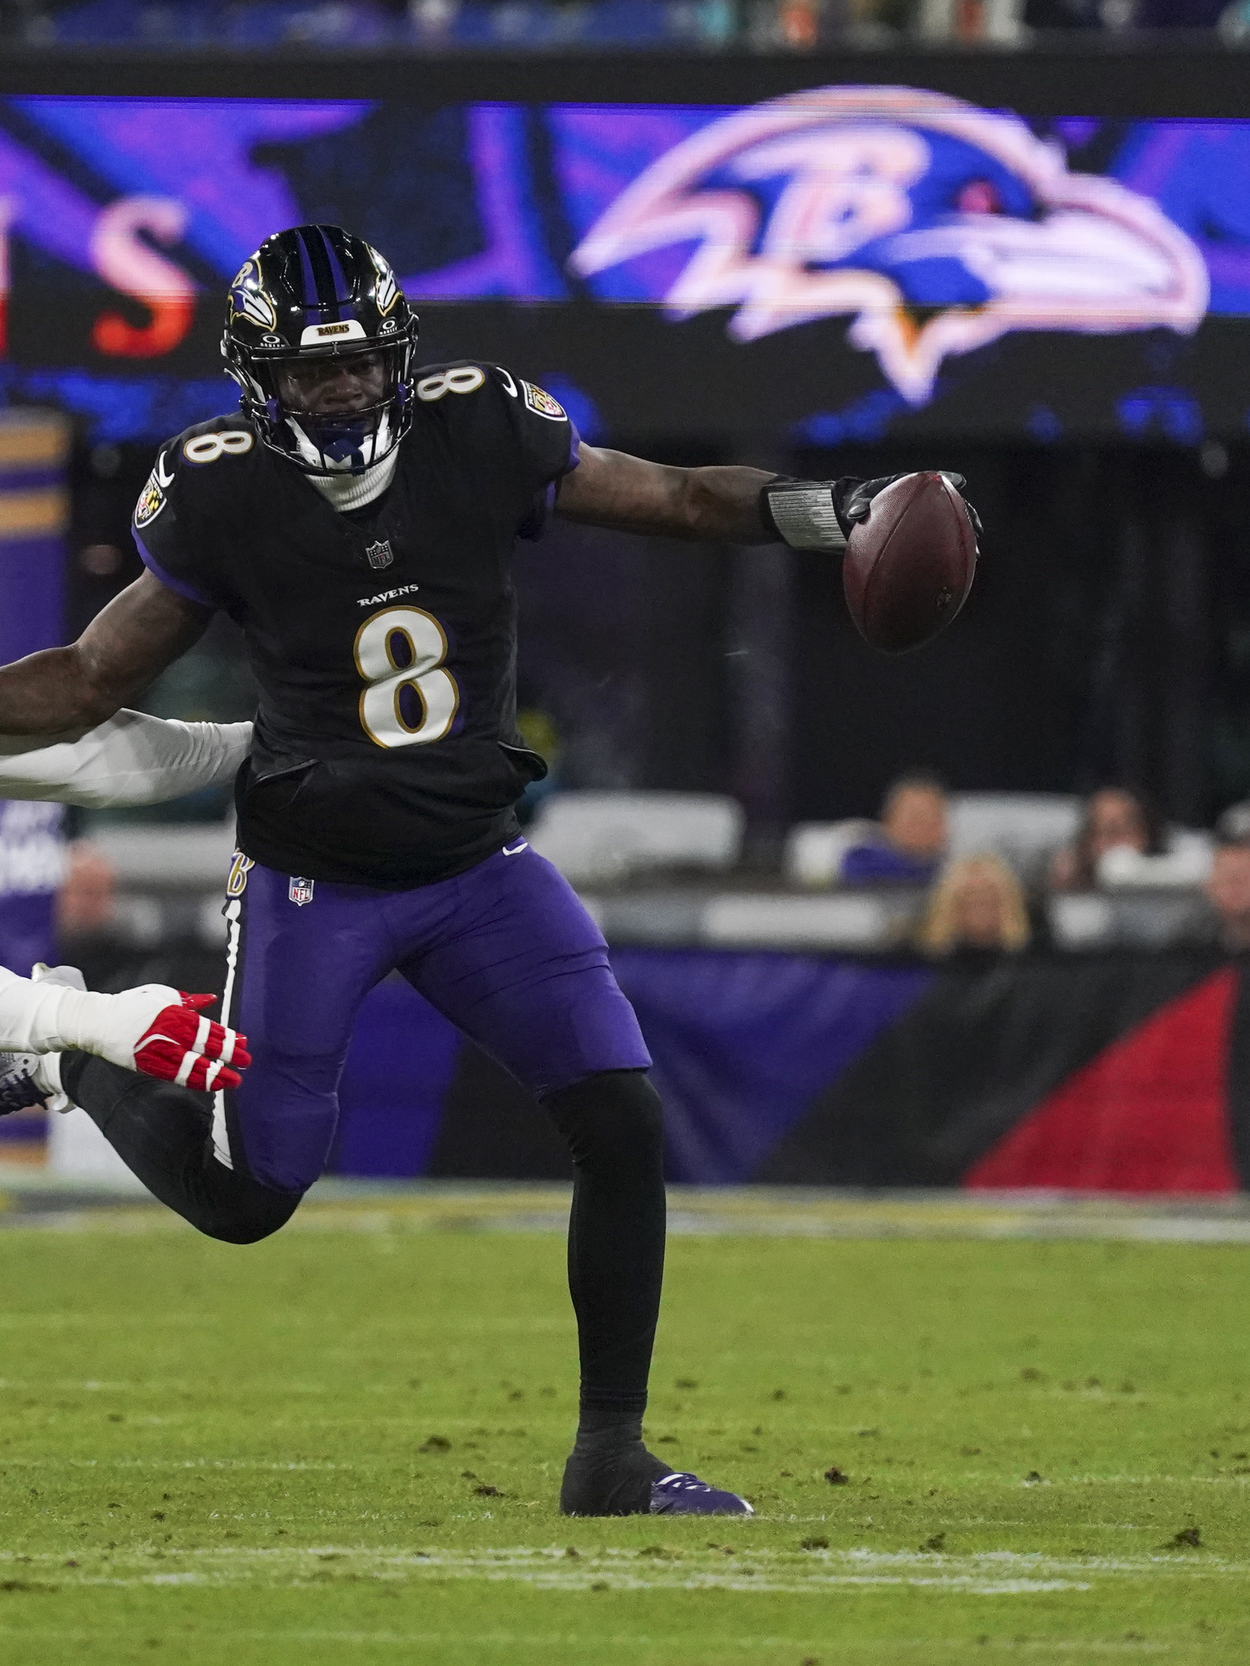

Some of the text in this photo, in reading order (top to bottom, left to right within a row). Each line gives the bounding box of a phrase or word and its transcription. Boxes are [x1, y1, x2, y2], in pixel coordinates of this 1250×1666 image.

[316, 324, 350, 337] RAVENS
[416, 366, 486, 402] 8
[183, 431, 254, 464] 8
[357, 584, 419, 607] RAVENS
[353, 605, 460, 749] 8
[292, 887, 309, 900] NFL
